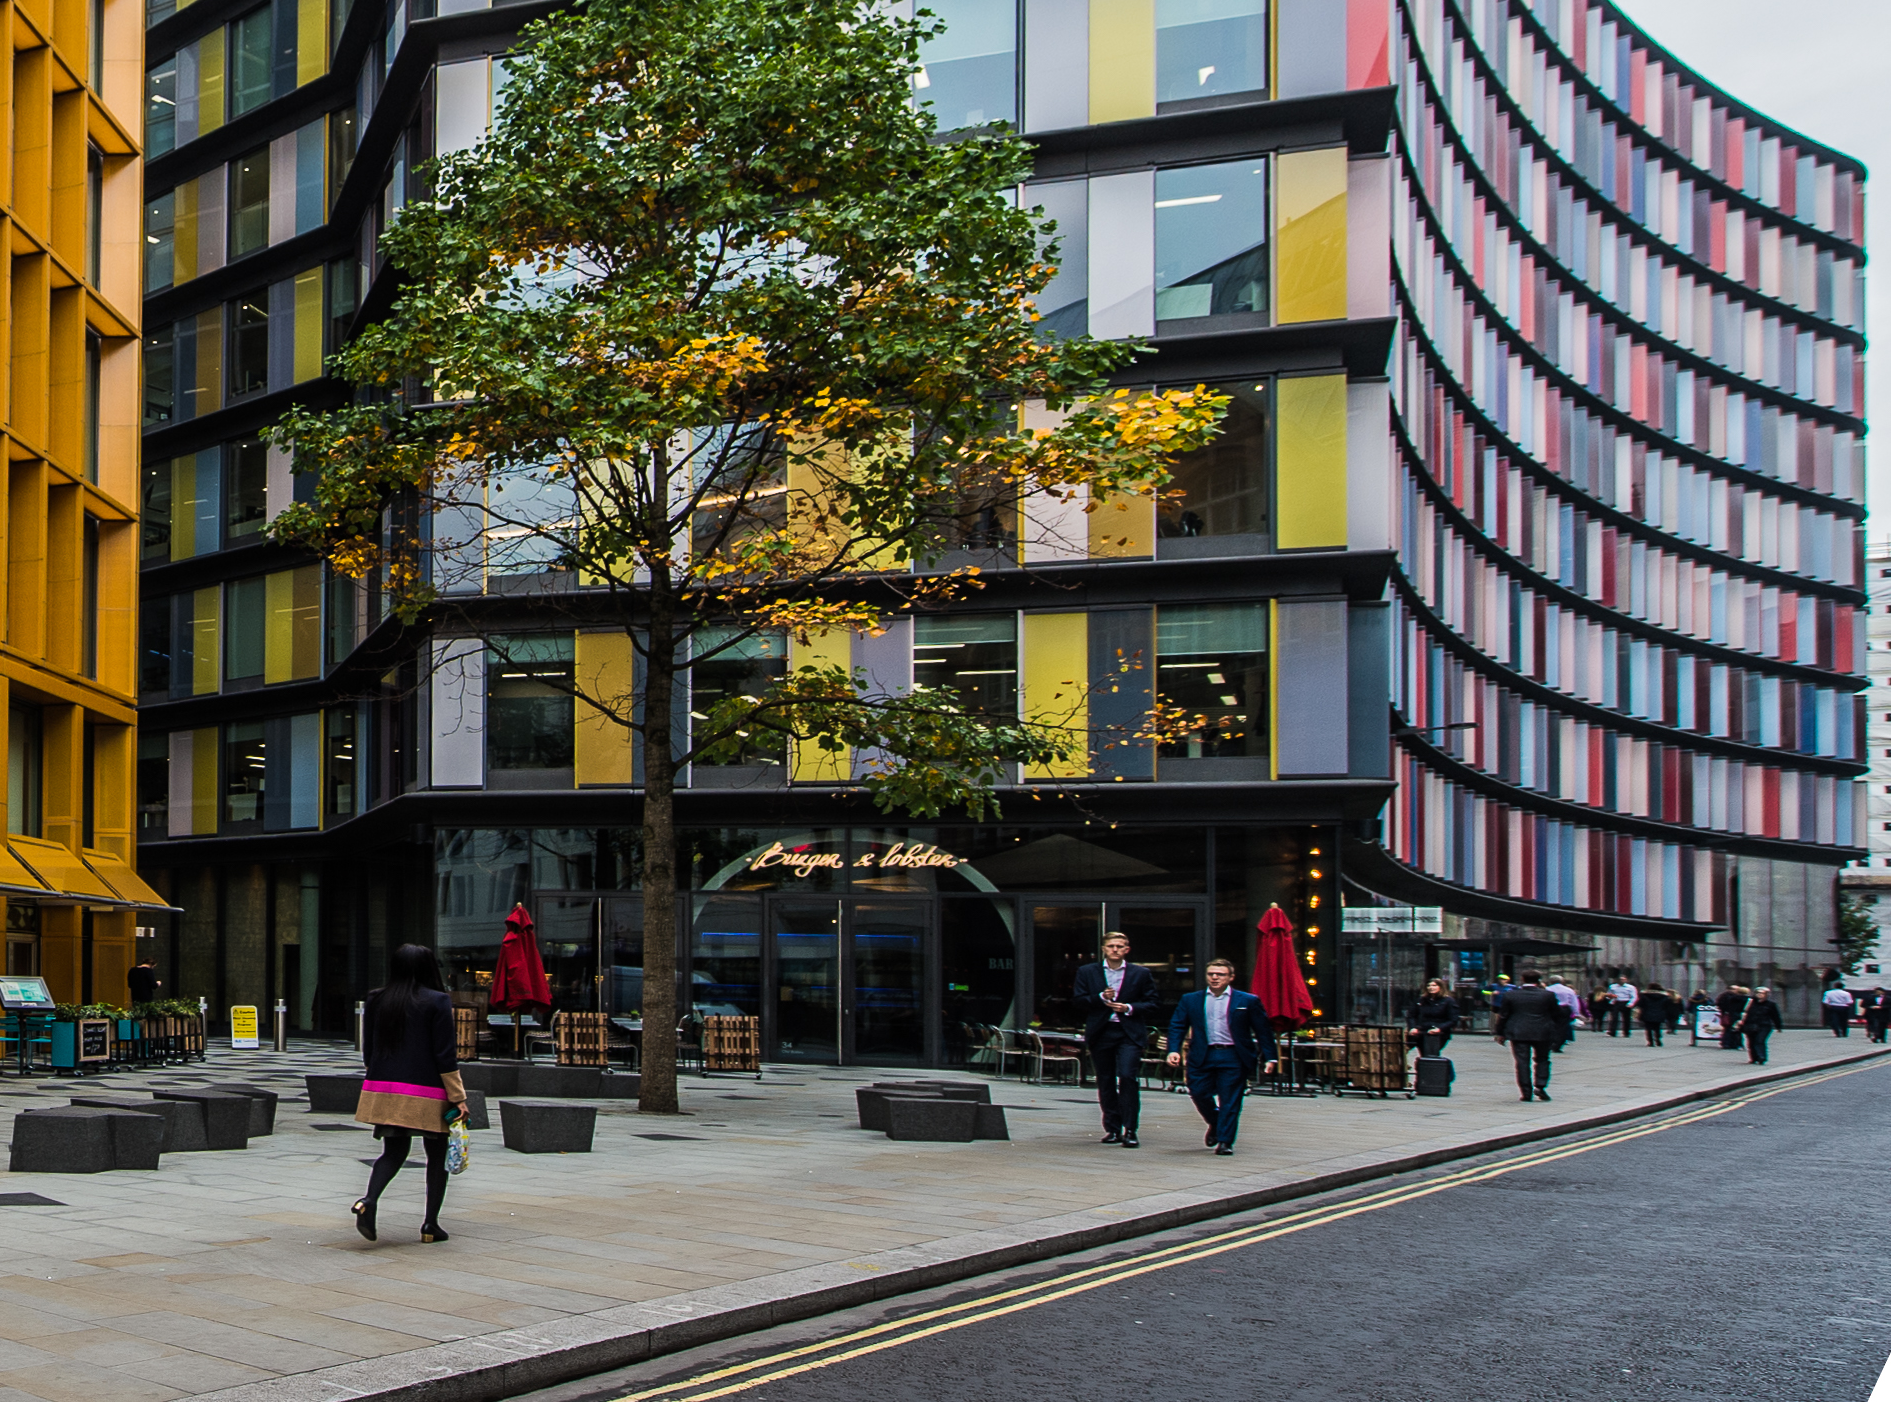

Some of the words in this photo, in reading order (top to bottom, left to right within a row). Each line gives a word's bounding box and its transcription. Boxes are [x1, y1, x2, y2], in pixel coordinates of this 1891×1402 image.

[749, 841, 844, 878] Burger
[853, 852, 876, 868] &
[988, 957, 1014, 970] BAR
